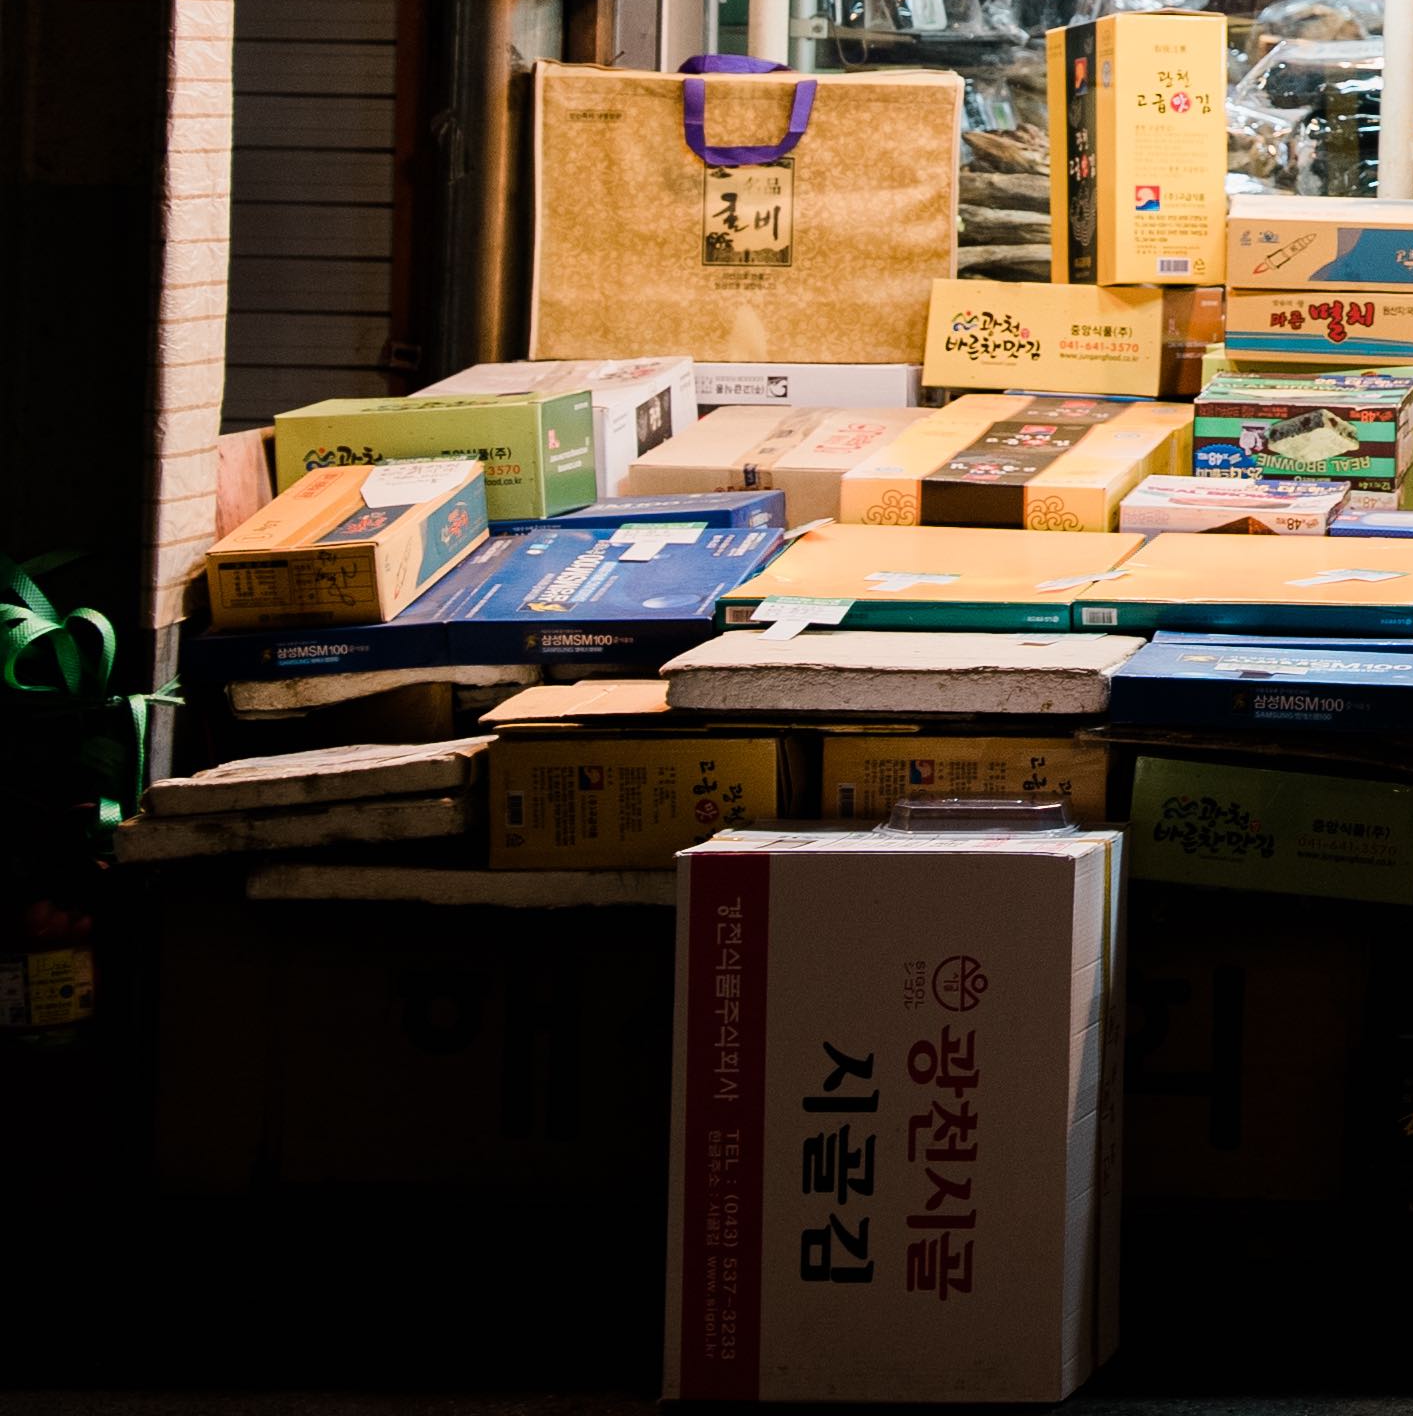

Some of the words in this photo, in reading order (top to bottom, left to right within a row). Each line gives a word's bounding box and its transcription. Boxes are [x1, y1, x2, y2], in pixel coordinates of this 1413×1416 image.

[979, 311, 1021, 338] 광천
[1071, 324, 1134, 339] 중앙식품(주)
[1308, 299, 1376, 343] 멸치
[945, 334, 1042, 361] 바른찬맛김
[1059, 340, 1140, 353] 041-641-3570
[1256, 453, 1328, 475] BROWNIE
[1331, 455, 1371, 472] REAL
[541, 633, 613, 647] 삼성MSM100
[1252, 694, 1345, 713] 삼성MSM100
[914, 960, 926, 1011] SIGOL
[801, 1040, 879, 1284] 시골김
[906, 1024, 980, 1301] 광천시골
[721, 1194, 740, 1249] (043)
[719, 1256, 740, 1361] 537-3233
